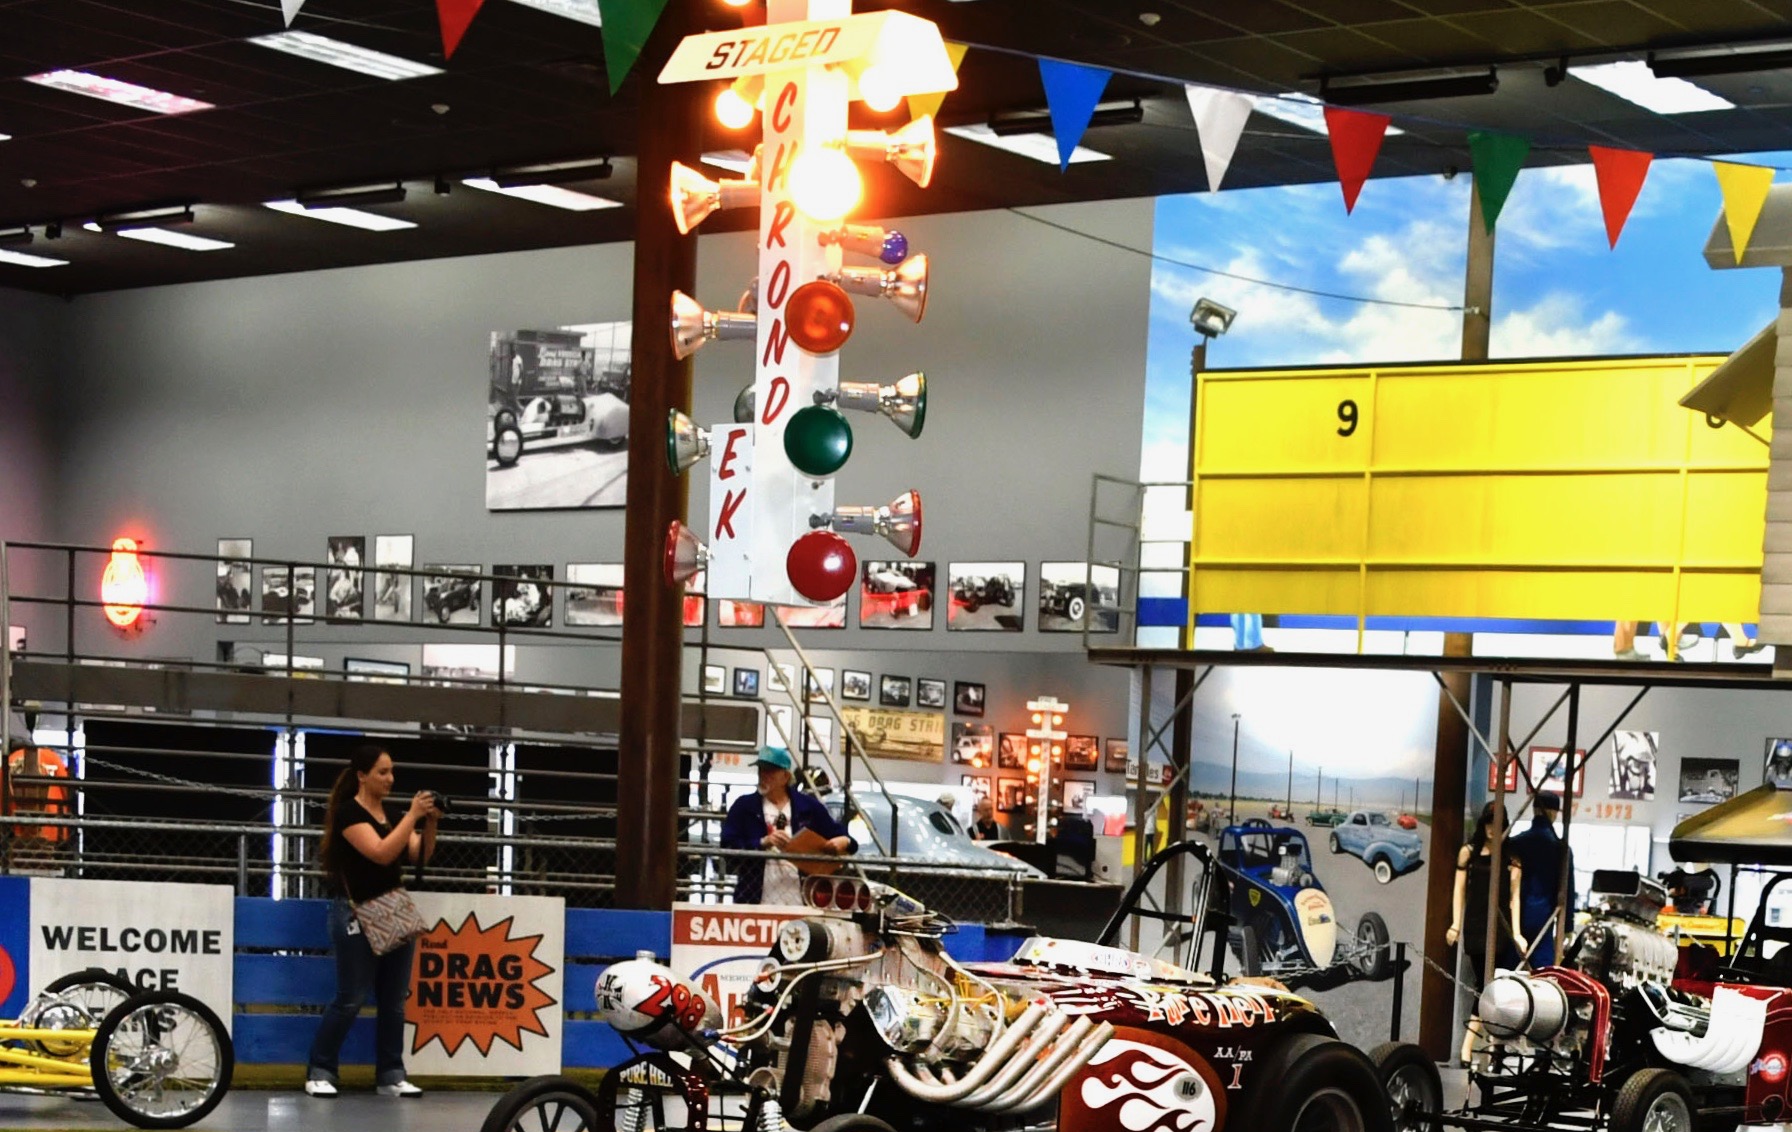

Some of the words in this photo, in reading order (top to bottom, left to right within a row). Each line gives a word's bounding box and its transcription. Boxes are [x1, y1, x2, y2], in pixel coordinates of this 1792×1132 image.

[705, 27, 841, 70] STAGED
[1336, 399, 1359, 437] 9
[868, 715, 902, 731] DRAG
[41, 925, 221, 955] WELCOME
[419, 952, 523, 981] DRAG
[417, 981, 525, 1010] NEWS
[633, 975, 706, 1031] 298
[1140, 990, 1210, 1027] Pure
[1209, 993, 1275, 1028] Hell
[1213, 1045, 1253, 1061] AA/PA
[620, 1061, 648, 1085] PURE
[649, 1063, 674, 1088] HELL
[1181, 1081, 1197, 1097] 116
[1227, 1064, 1242, 1090] 1
